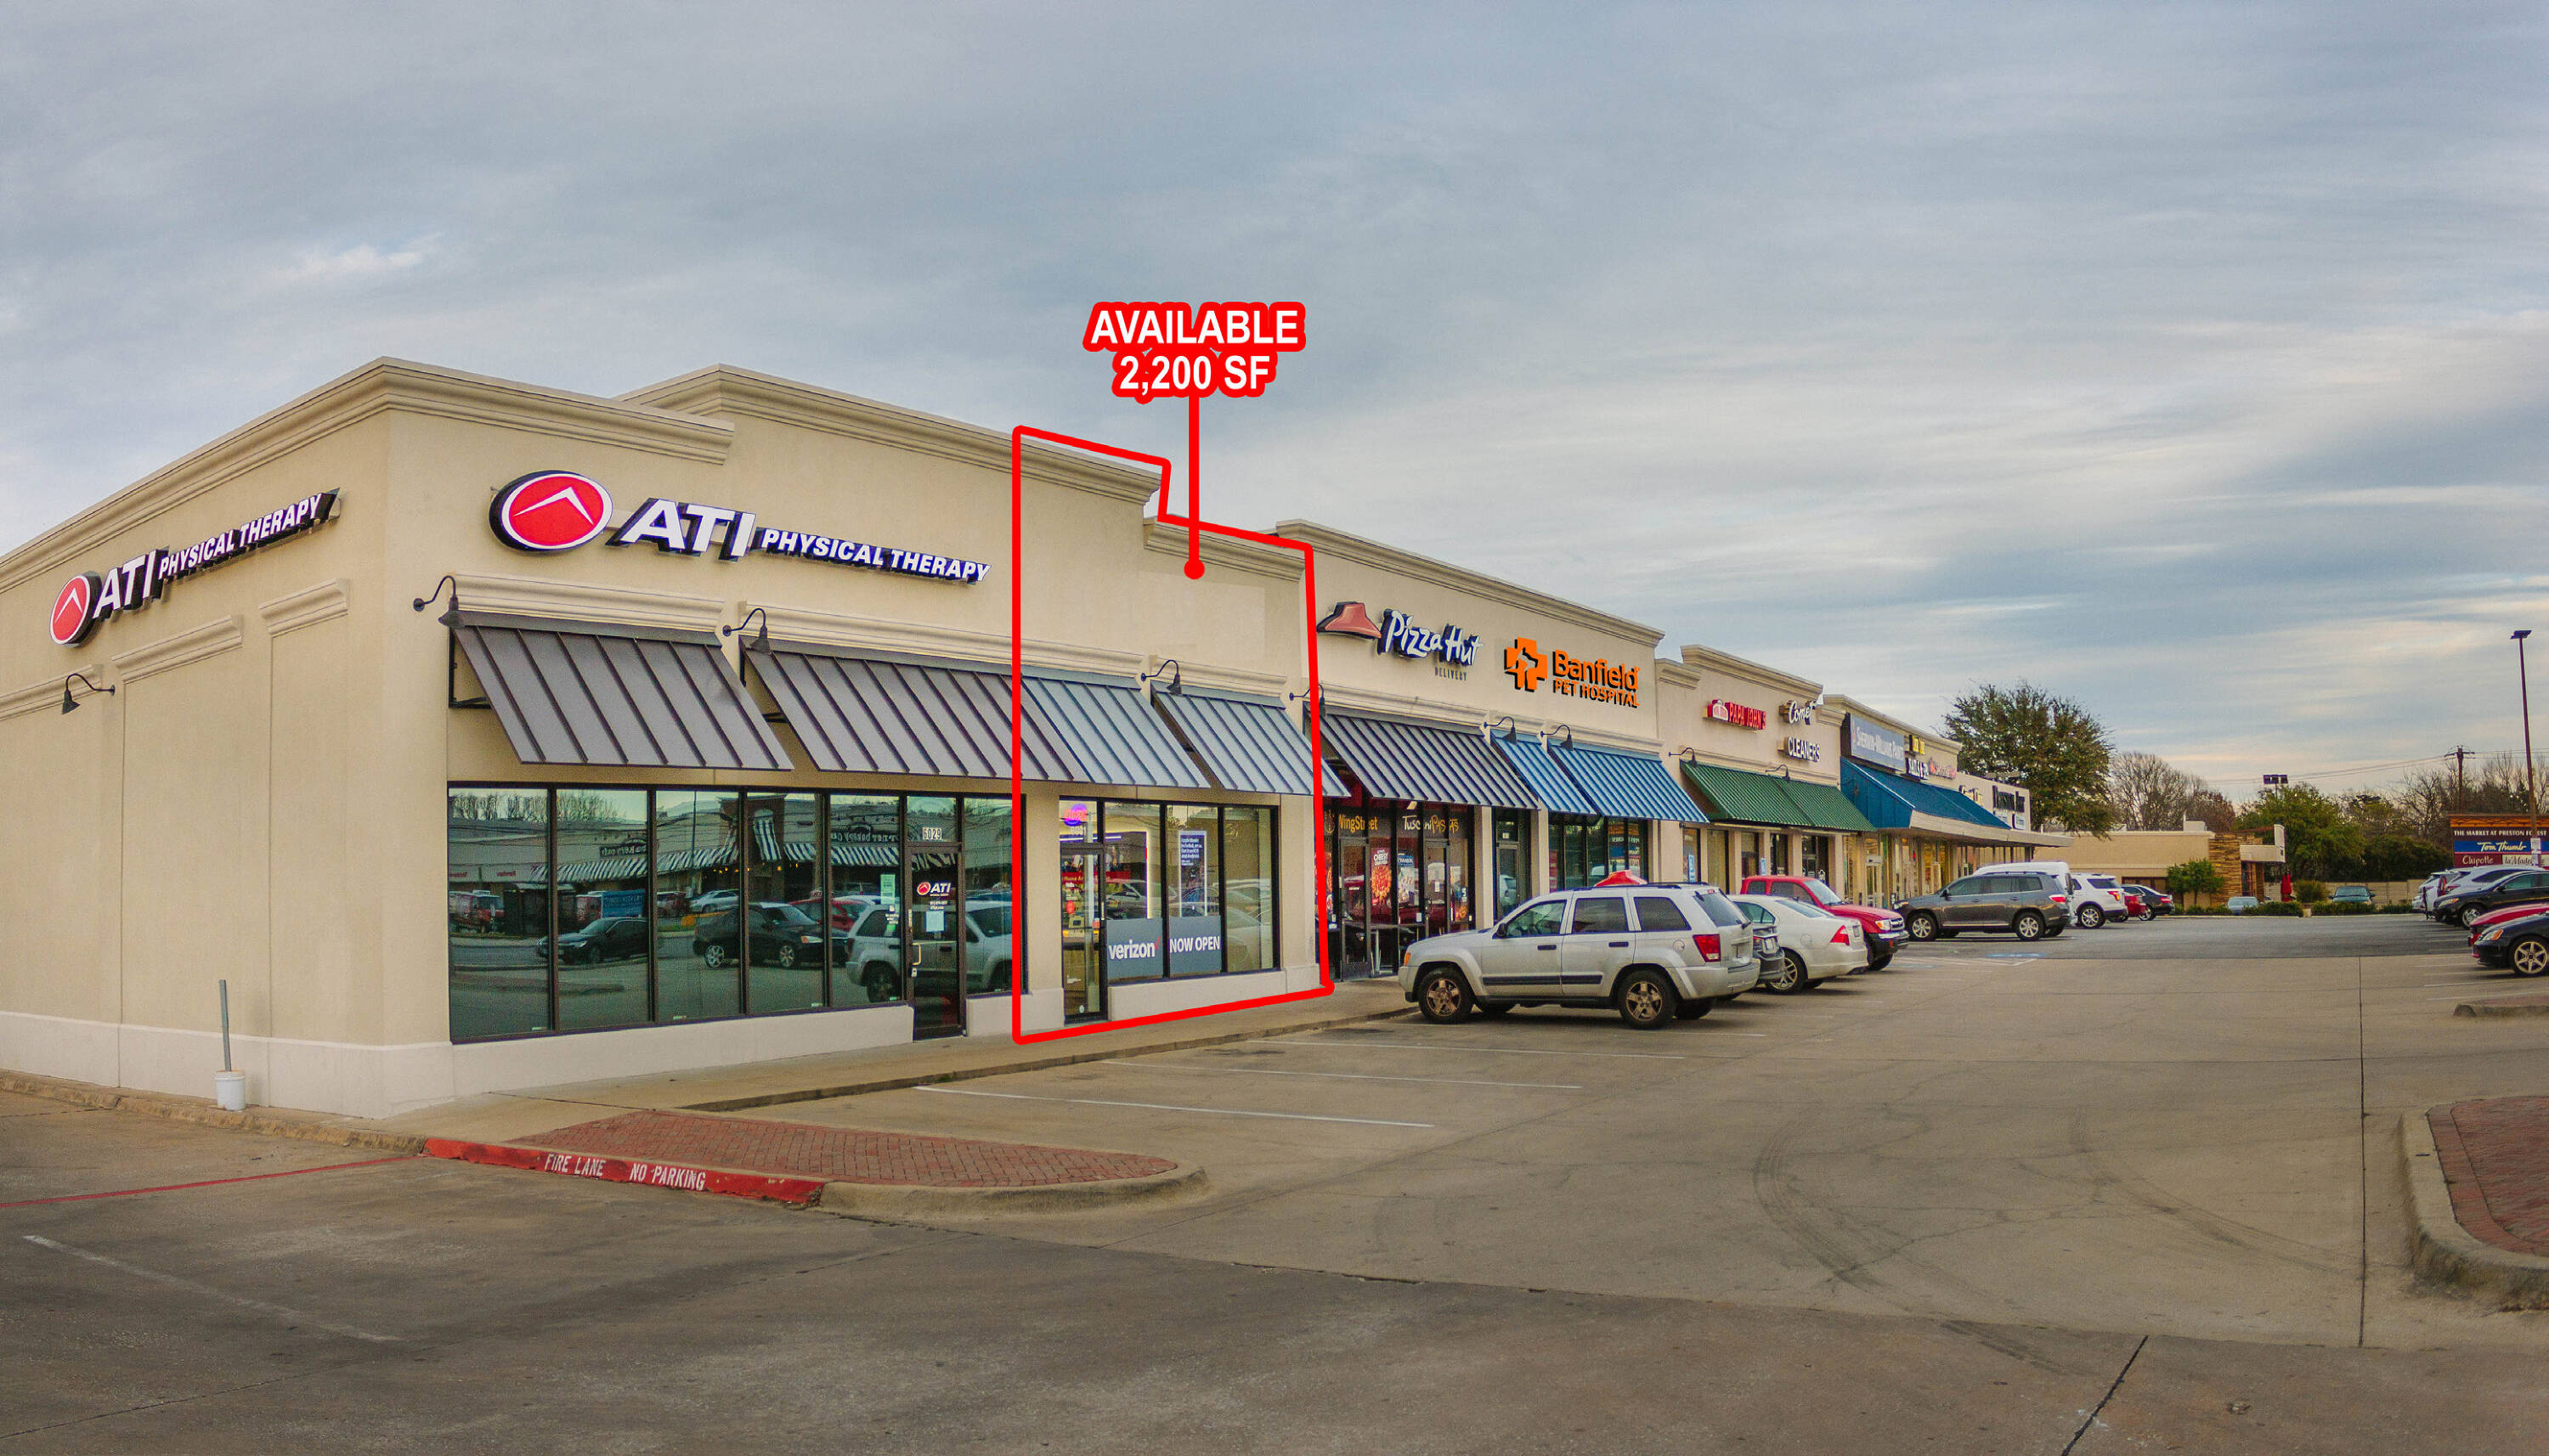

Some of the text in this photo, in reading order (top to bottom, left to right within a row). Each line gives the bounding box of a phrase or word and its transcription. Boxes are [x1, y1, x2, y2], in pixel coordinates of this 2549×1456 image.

[619, 498, 992, 582] ATI PHYSICAL THERAPY
[92, 493, 322, 619] ATI PHYSICAL THERAPY
[1383, 609, 1484, 666] Pizza Hut
[1433, 665, 1468, 682] DELIVERY
[1553, 648, 1640, 691] Banfield
[1553, 677, 1641, 708] PET HOSPITAL
[1728, 701, 1745, 725] PAPA
[1788, 736, 1820, 762] CLEANERS
[923, 828, 941, 839] 6029
[2477, 840, 2527, 852] Tom Thumb
[2462, 855, 2494, 866] Chipotle
[930, 883, 952, 893] ATI
[1108, 940, 1156, 960] verizon
[1169, 935, 1220, 953] NOW OPEN
[542, 1153, 706, 1191] FIRE LANE NO PARKING
